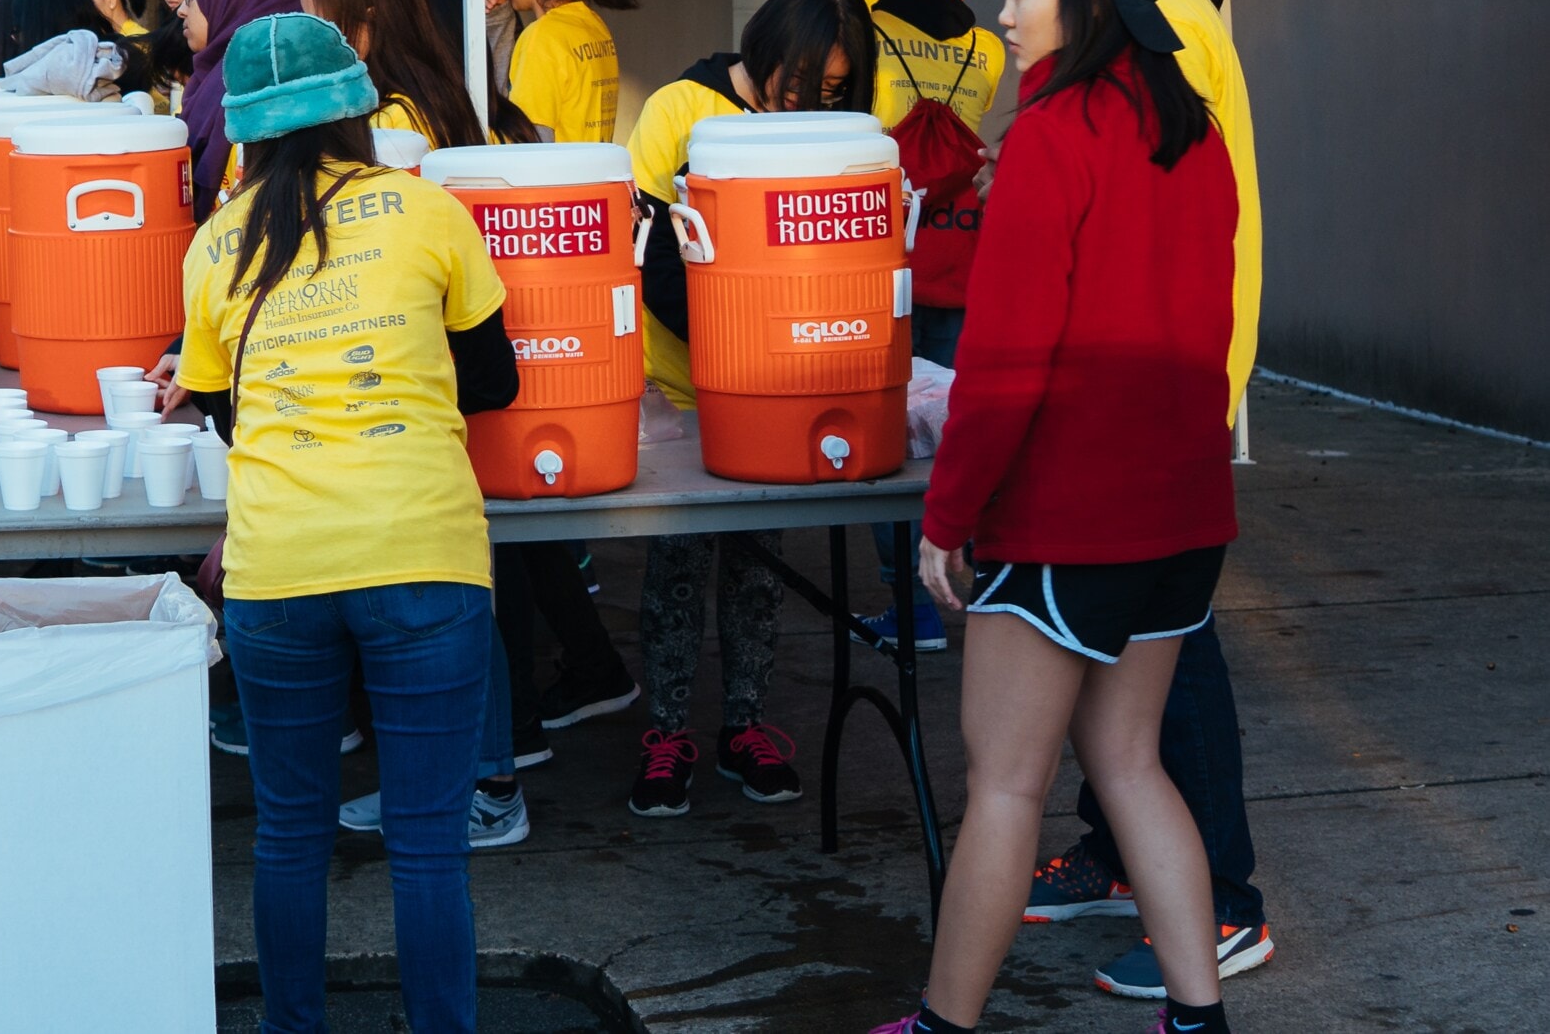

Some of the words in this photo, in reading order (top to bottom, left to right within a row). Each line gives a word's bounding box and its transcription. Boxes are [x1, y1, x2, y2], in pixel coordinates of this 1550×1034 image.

[484, 202, 602, 232] HOUSTON
[778, 187, 886, 218] HOUSTON
[207, 191, 405, 265] VOTEER
[775, 215, 888, 244] ROCKETS
[483, 230, 603, 258] ROCKETS
[263, 274, 358, 308] MEMORIAL
[263, 285, 358, 319] HERMANN
[265, 312, 296, 330] Health
[297, 306, 343, 323] Insurance
[345, 300, 360, 311] Co
[244, 327, 328, 358] ARTICIPATING
[332, 314, 407, 337] PARTNERS
[791, 319, 868, 343] IGLOO
[511, 336, 581, 360] GLOO
[265, 368, 296, 381] adidas
[290, 441, 323, 451] TOYOTA
